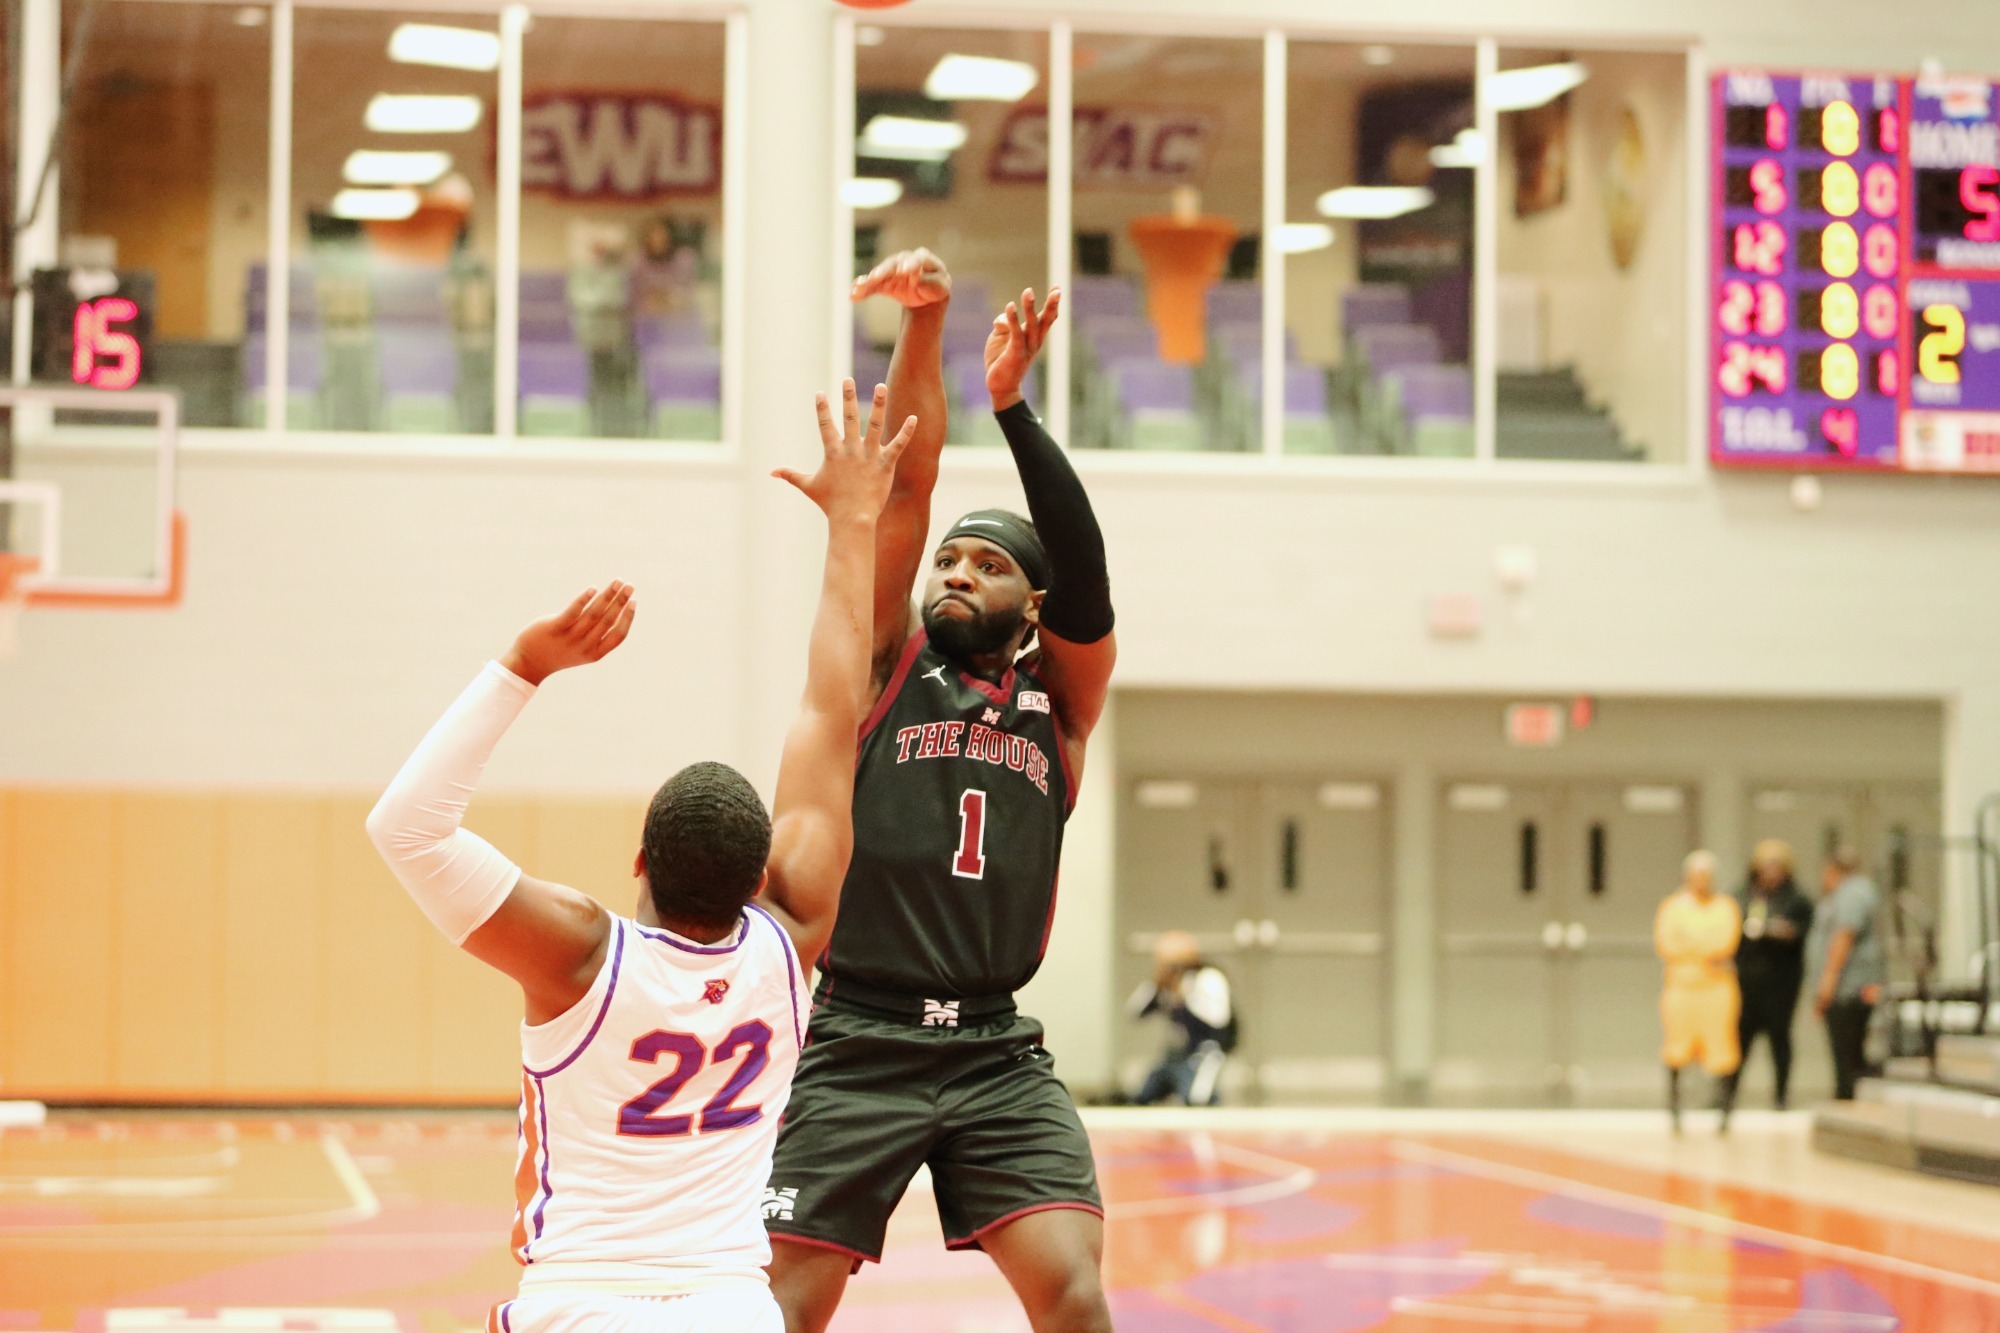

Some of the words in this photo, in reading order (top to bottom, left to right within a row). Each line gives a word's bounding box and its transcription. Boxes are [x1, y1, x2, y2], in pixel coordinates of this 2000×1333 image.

[521, 99, 712, 191] EWU
[1822, 101, 1860, 156] 0
[1822, 161, 1860, 217] 0
[1863, 162, 1899, 219] 0
[1821, 221, 1860, 278] 0
[1863, 222, 1899, 279] 0
[72, 297, 141, 390] 15
[1821, 281, 1860, 339] 0
[1863, 282, 1899, 340] 0
[1918, 303, 1966, 385] 2
[1820, 342, 1860, 400] 0
[1820, 407, 1859, 457] 4
[896, 721, 965, 764] THE
[965, 722, 1049, 796] HOUSE
[952, 788, 986, 880] 1
[616, 1018, 773, 1138] 22
